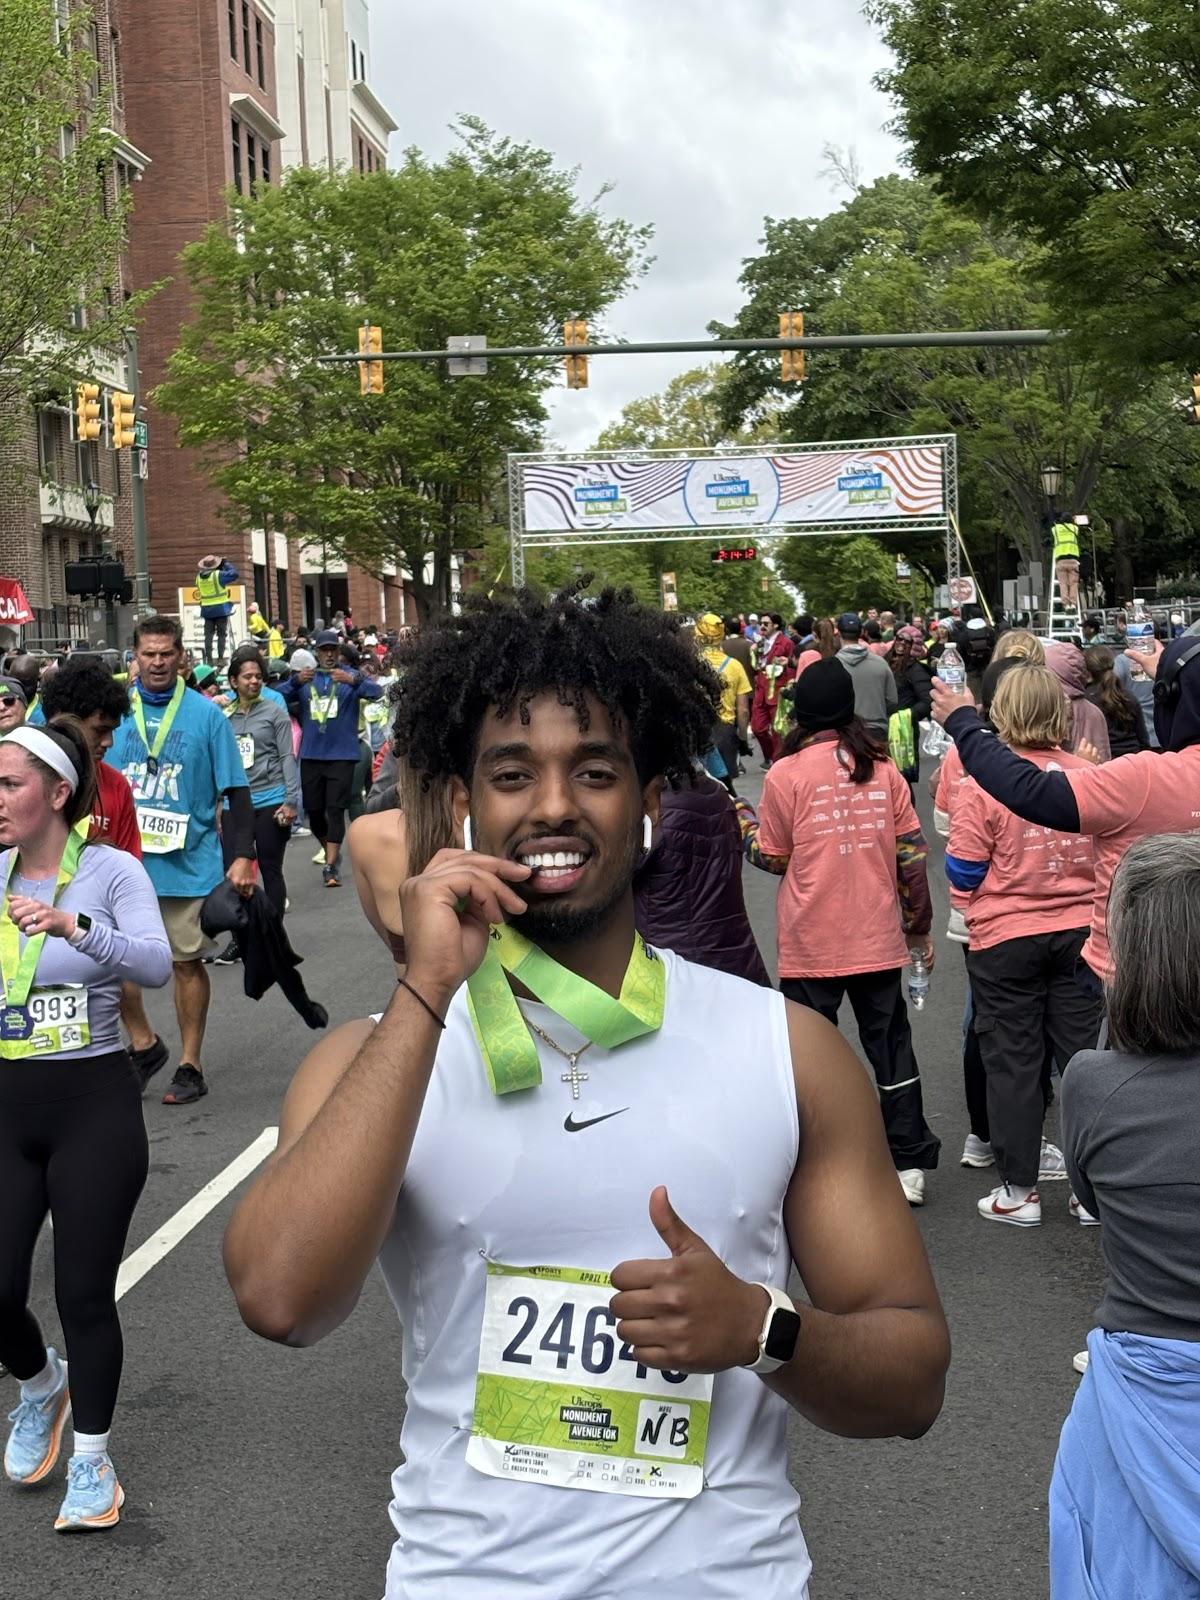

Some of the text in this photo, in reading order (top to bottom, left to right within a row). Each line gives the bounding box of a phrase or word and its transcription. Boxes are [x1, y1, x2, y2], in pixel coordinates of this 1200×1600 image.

[708, 484, 747, 495] MONUMENT
[142, 815, 181, 835] 14861
[580, 1272, 601, 1284] APRIL
[562, 1409, 608, 1424] MONUMENT
[571, 1425, 617, 1440] AVENUE 10K
